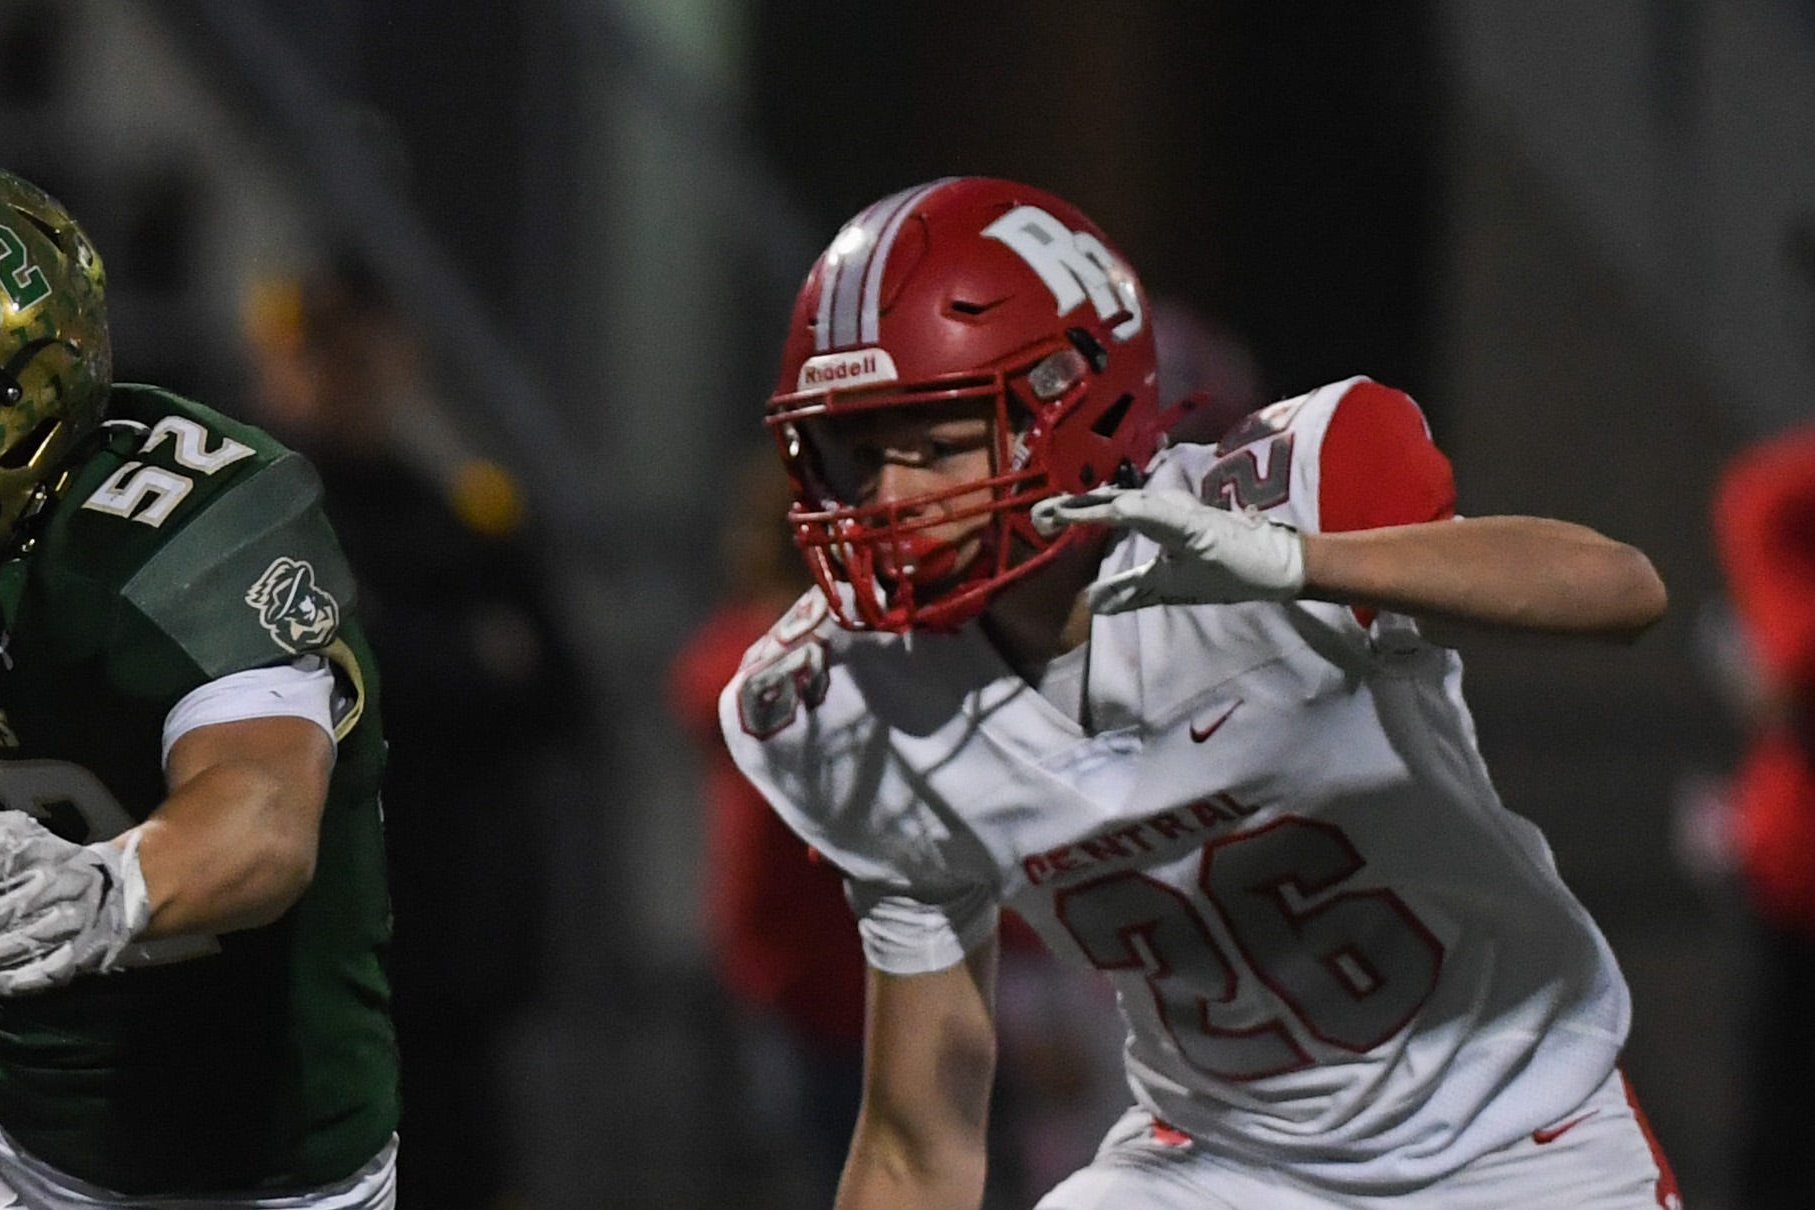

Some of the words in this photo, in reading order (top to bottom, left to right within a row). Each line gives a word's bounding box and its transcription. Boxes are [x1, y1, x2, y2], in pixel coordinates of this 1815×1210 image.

[804, 355, 877, 384] Riddell
[81, 415, 256, 528] 52
[1022, 790, 1260, 886] CENTRAL
[1054, 814, 1445, 1083] 26
